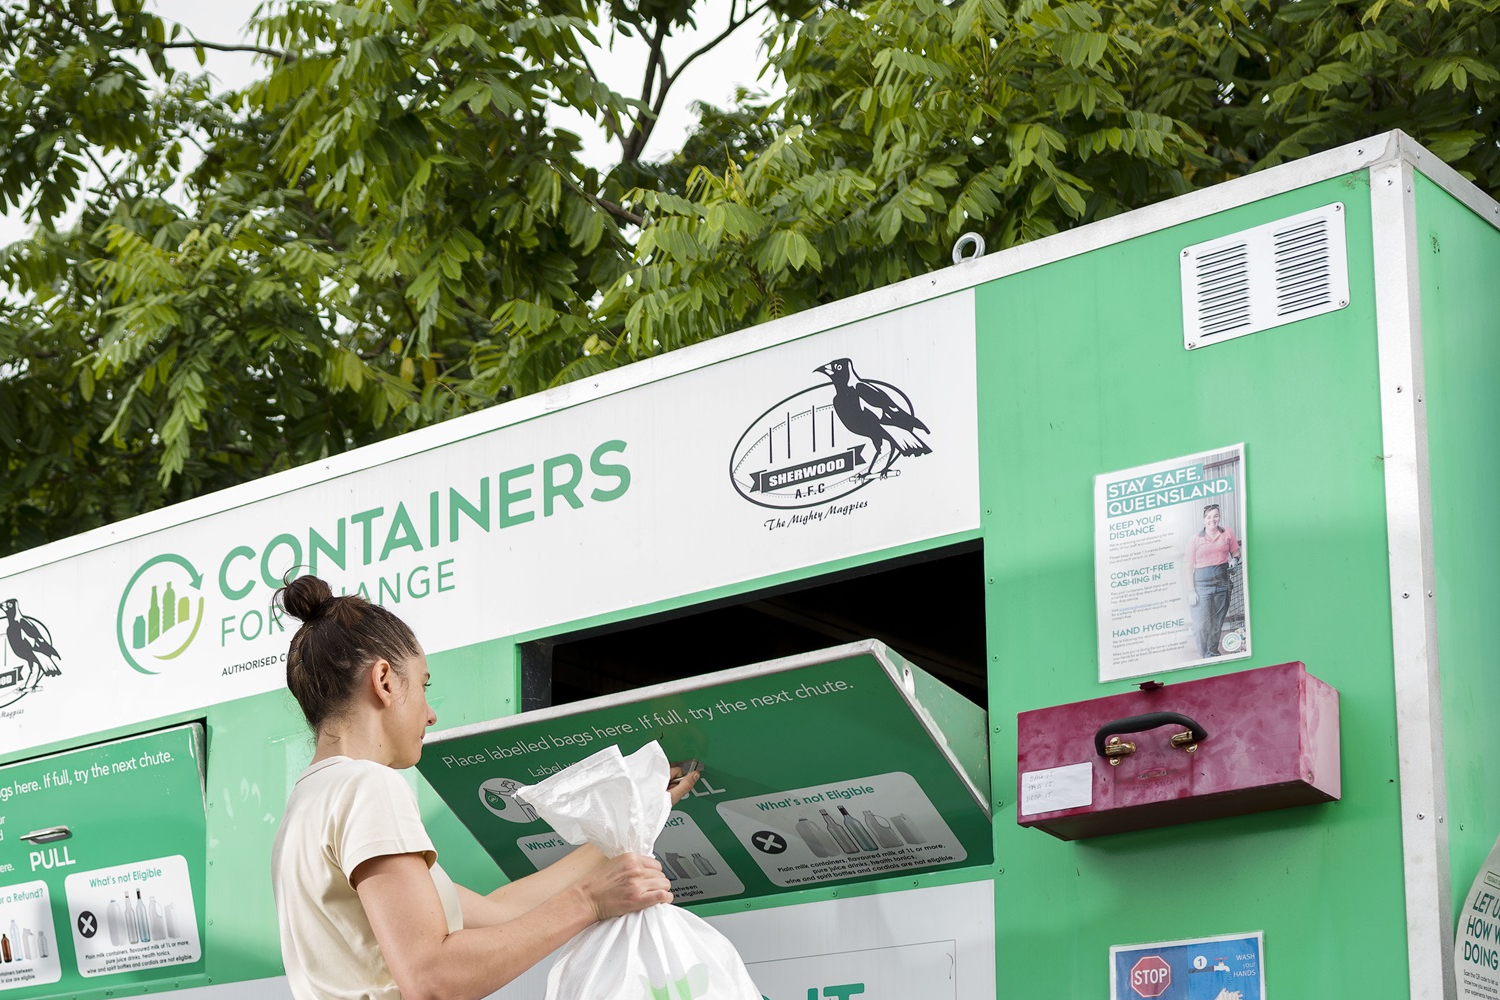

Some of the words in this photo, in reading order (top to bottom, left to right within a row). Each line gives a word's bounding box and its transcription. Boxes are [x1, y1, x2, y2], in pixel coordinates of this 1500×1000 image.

[769, 458, 845, 487] SHERWOOD
[1108, 478, 1147, 498] STAY
[1153, 467, 1201, 488] SAFE,
[795, 483, 825, 499] A.F.C
[1109, 479, 1232, 515] QUEENSLAND.
[218, 439, 631, 600] CONTAINERS
[764, 518, 785, 531] The
[787, 510, 823, 528] Mighty
[824, 500, 868, 519] Magpies
[1109, 520, 1134, 531] KEEP
[1136, 515, 1162, 526] YOUR
[1109, 525, 1155, 540] DISTANCE
[1110, 562, 1174, 580] CONTACT-FREE
[1110, 576, 1149, 588] CASHING
[1152, 573, 1161, 581] IN
[221, 604, 285, 647] FOR
[341, 559, 455, 606] ANGE
[1112, 626, 1140, 638] HAND
[1143, 618, 1185, 632] HYGIENE
[442, 752, 486, 769] Place
[484, 737, 551, 760] labelled
[549, 730, 593, 747] bags
[591, 722, 639, 739] here.
[638, 714, 652, 729] If
[653, 709, 688, 727] full,
[688, 707, 714, 720] try
[716, 699, 747, 714] the
[750, 690, 793, 708] next
[795, 680, 854, 699] chute.
[14, 780, 41, 795] here.
[43, 772, 50, 788] If
[52, 769, 72, 786] full,
[74, 769, 89, 784] try
[91, 762, 110, 778] the
[112, 757, 137, 773] next
[139, 751, 174, 767] chute.
[756, 797, 801, 812] What's
[803, 793, 825, 805] not
[827, 785, 875, 800] Eligible
[29, 846, 76, 872] PULL
[89, 876, 116, 888] What's
[117, 873, 131, 883] not
[133, 868, 162, 881] Eligible
[13, 888, 44, 902] Refund?
[1472, 890, 1495, 914] LET
[1466, 915, 1493, 942] HOW
[1236, 953, 1256, 961] WASH
[1463, 940, 1499, 970] DOING
[1134, 968, 1168, 986] STOP
